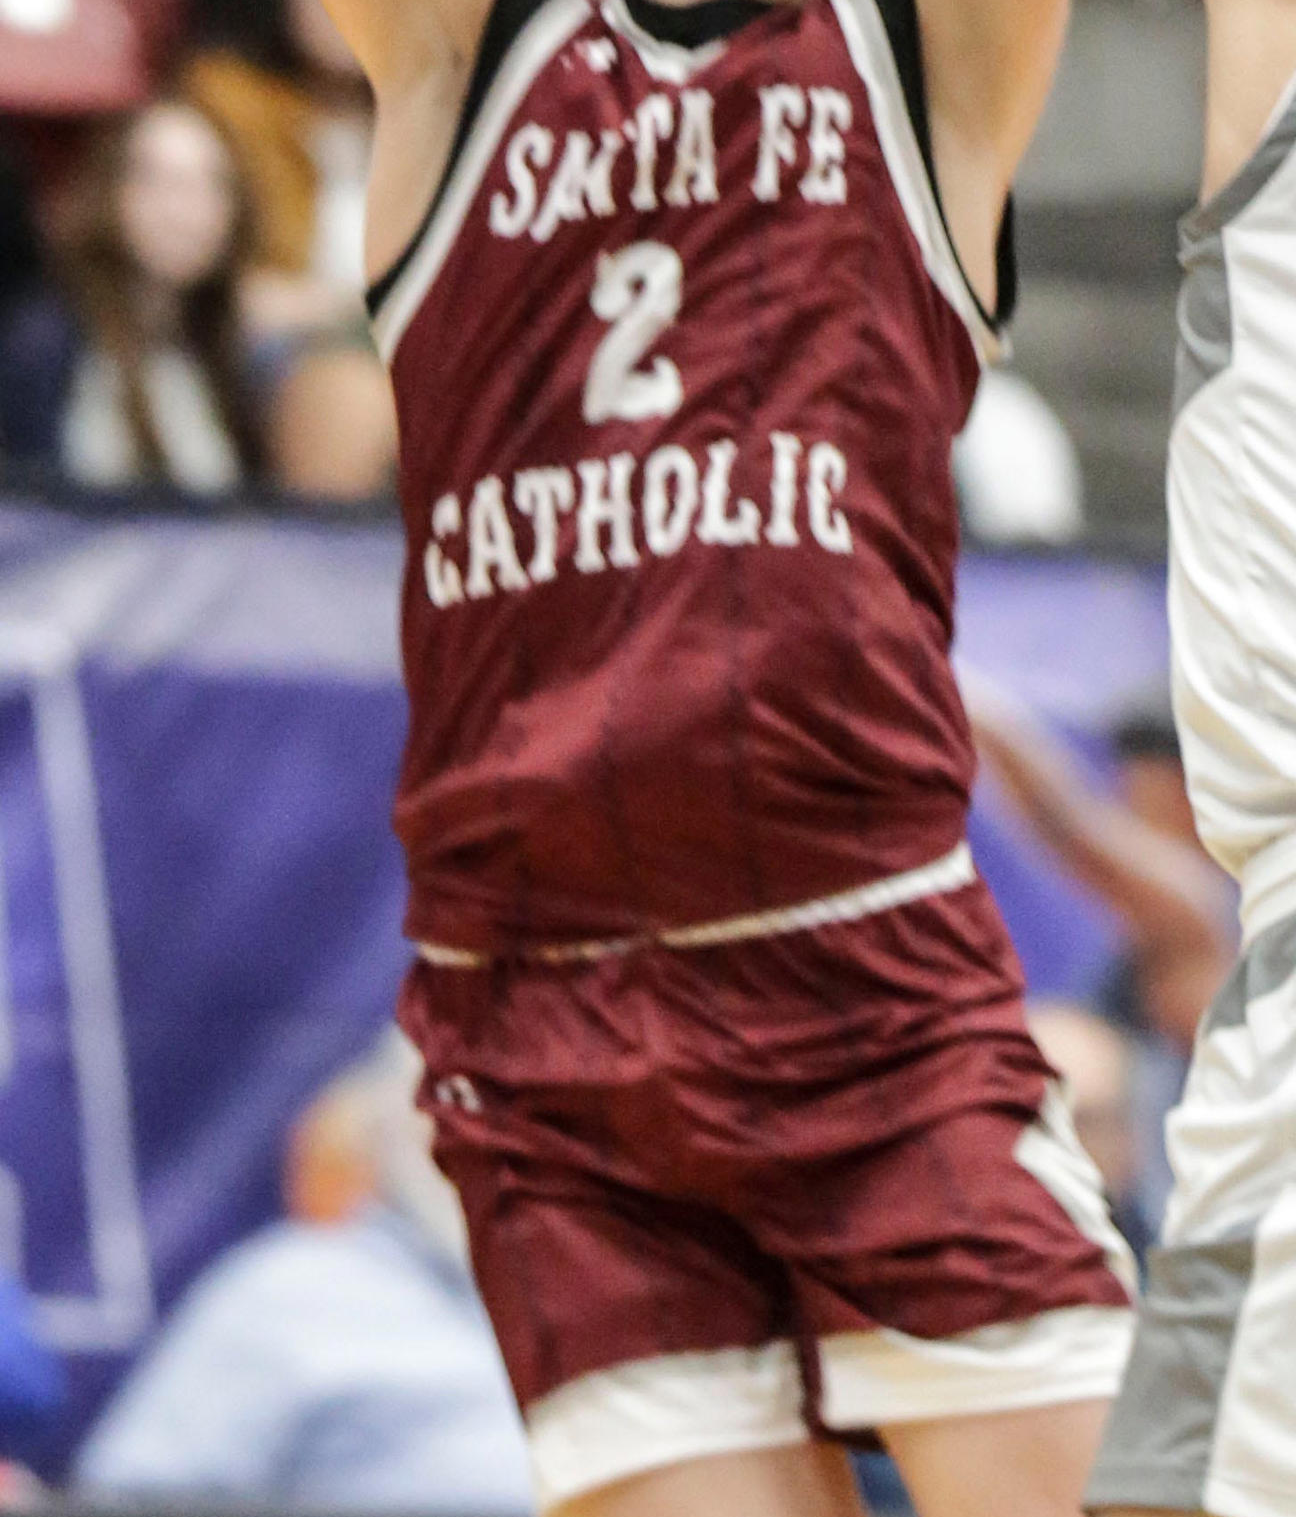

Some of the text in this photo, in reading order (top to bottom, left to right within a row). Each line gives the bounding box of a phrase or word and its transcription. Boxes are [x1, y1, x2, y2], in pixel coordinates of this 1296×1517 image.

[752, 84, 852, 204] FE
[584, 241, 684, 424] 2
[425, 431, 854, 608] CATHOLIC
